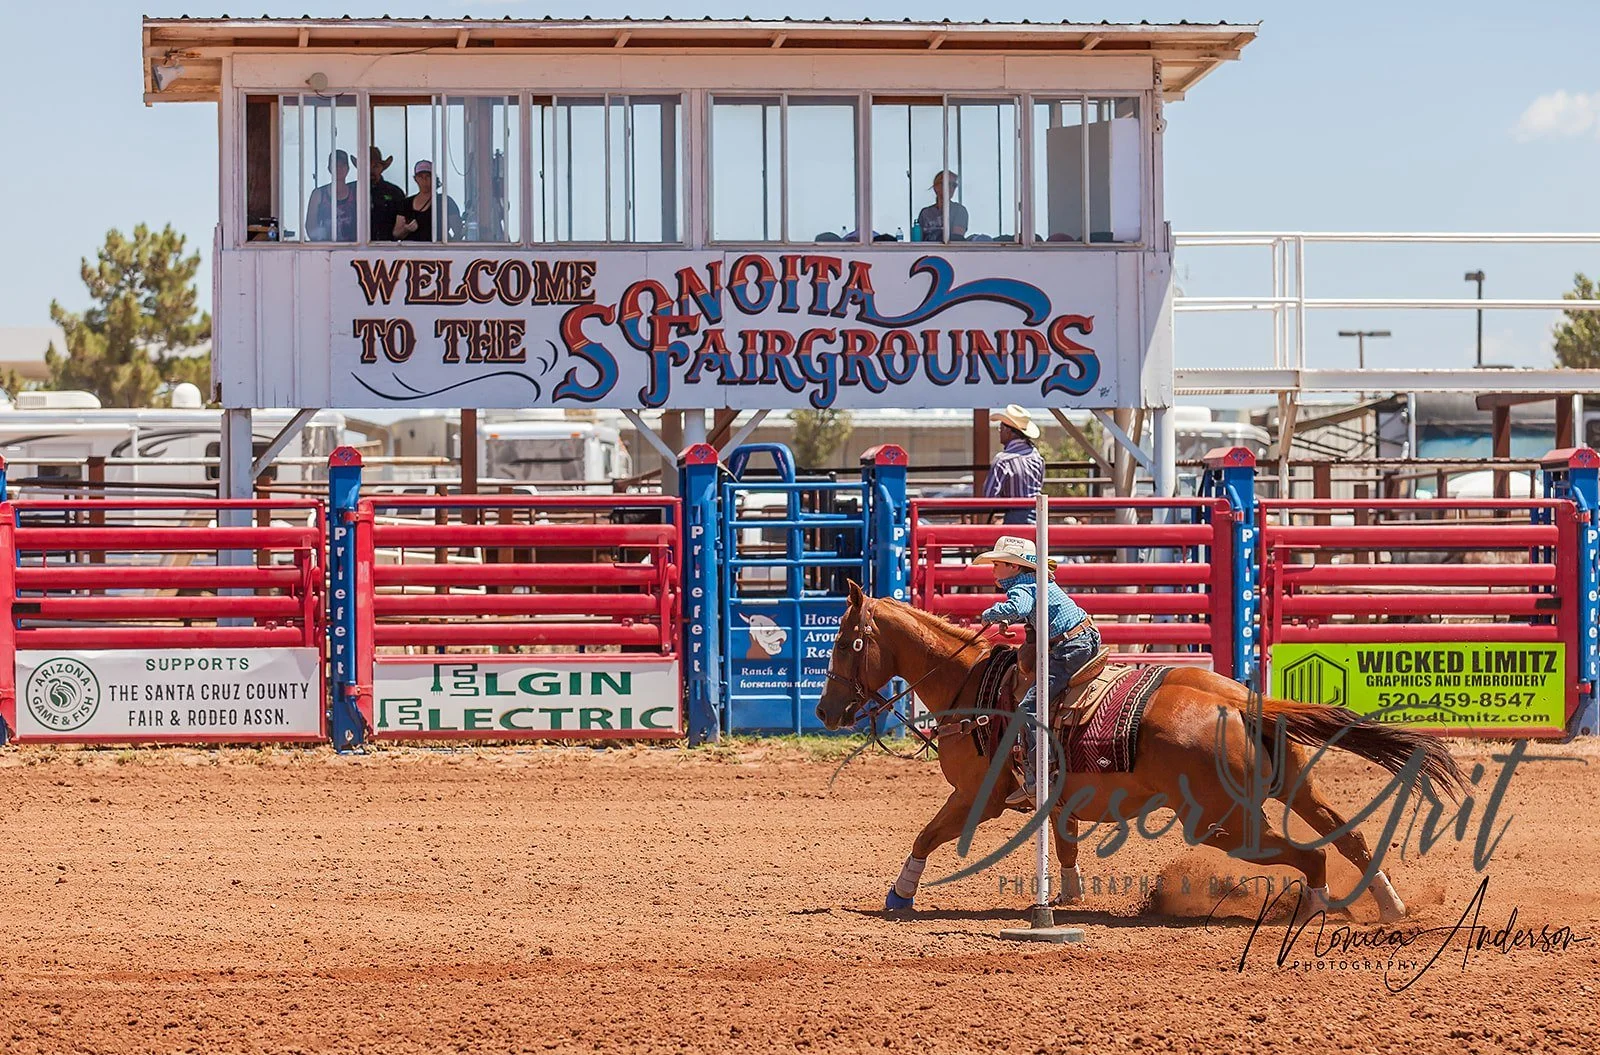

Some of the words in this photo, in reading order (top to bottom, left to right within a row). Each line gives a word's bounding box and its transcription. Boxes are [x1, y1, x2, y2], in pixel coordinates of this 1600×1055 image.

[350, 258, 597, 306] WELCOME
[353, 317, 416, 364] TO
[434, 317, 527, 364] THE
[552, 253, 878, 403] SONOITA
[638, 313, 1101, 409] FAIRGROUNDS
[334, 527, 348, 675] Priefert
[691, 525, 704, 673] Priefert
[1242, 528, 1253, 675] Priefert
[35, 663, 91, 687] ARIZONA
[146, 657, 250, 671] SUPPORTS
[741, 666, 773, 676] Ranch
[777, 667, 788, 676] &
[1357, 651, 1465, 674] WICKED
[1471, 650, 1557, 674] LIMITZ
[109, 685, 138, 701] THE
[145, 684, 195, 701] SANTA
[201, 684, 241, 700] CRUZ
[246, 683, 309, 700] COUNTY
[431, 663, 632, 697] ELGIN
[1366, 675, 1432, 687] GRAPHICS
[1435, 675, 1461, 687] AND
[1464, 674, 1547, 687] EMBROIDERY
[33, 696, 60, 725] GAME
[61, 716, 70, 726] &
[72, 696, 94, 722] FISH
[378, 698, 674, 731] ELECTRIC
[1378, 692, 1536, 708] 520-459-8547
[128, 710, 164, 727] FAIR
[170, 710, 180, 726] &
[188, 710, 237, 726] RODEO
[244, 709, 289, 726] ASSN.
